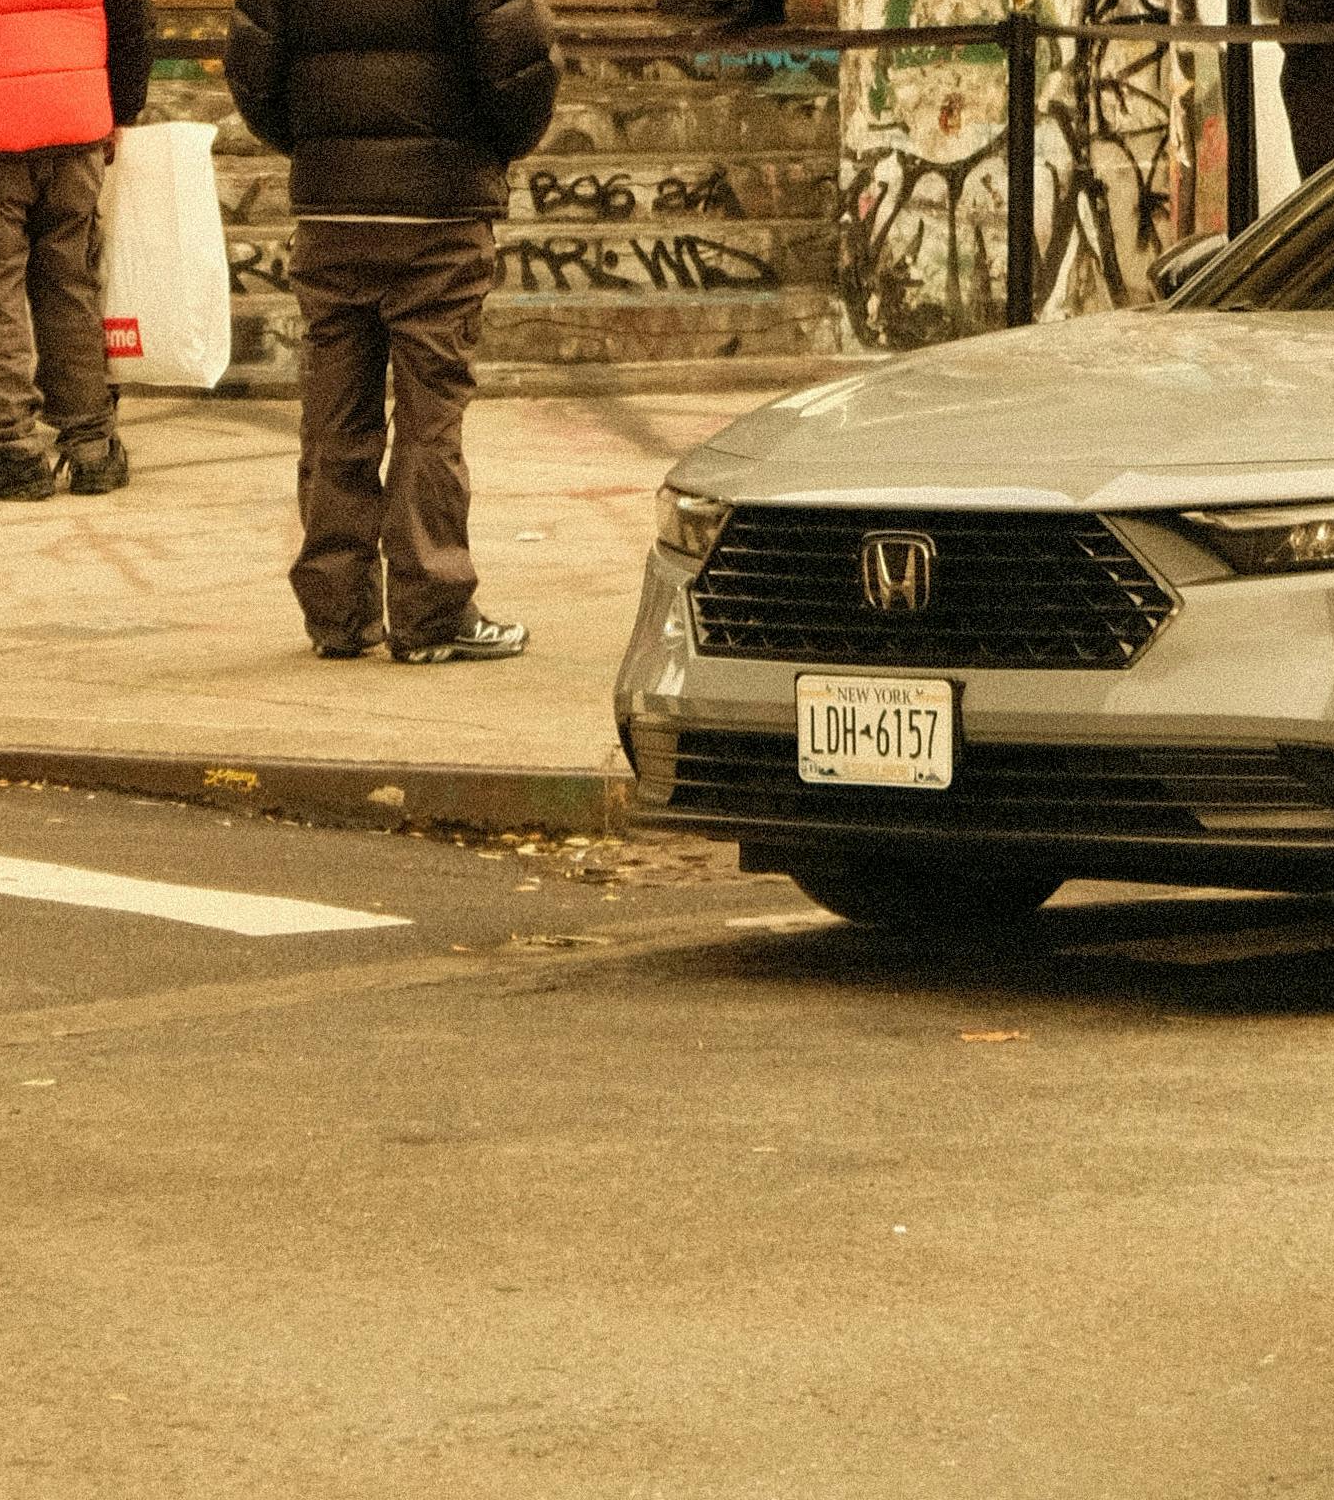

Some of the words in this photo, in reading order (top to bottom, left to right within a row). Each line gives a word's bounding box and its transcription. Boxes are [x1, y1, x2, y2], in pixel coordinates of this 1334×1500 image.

[837, 686, 868, 702] NEW
[873, 688, 911, 705] YORK
[810, 705, 857, 756] LDH
[875, 709, 938, 760] 6157
